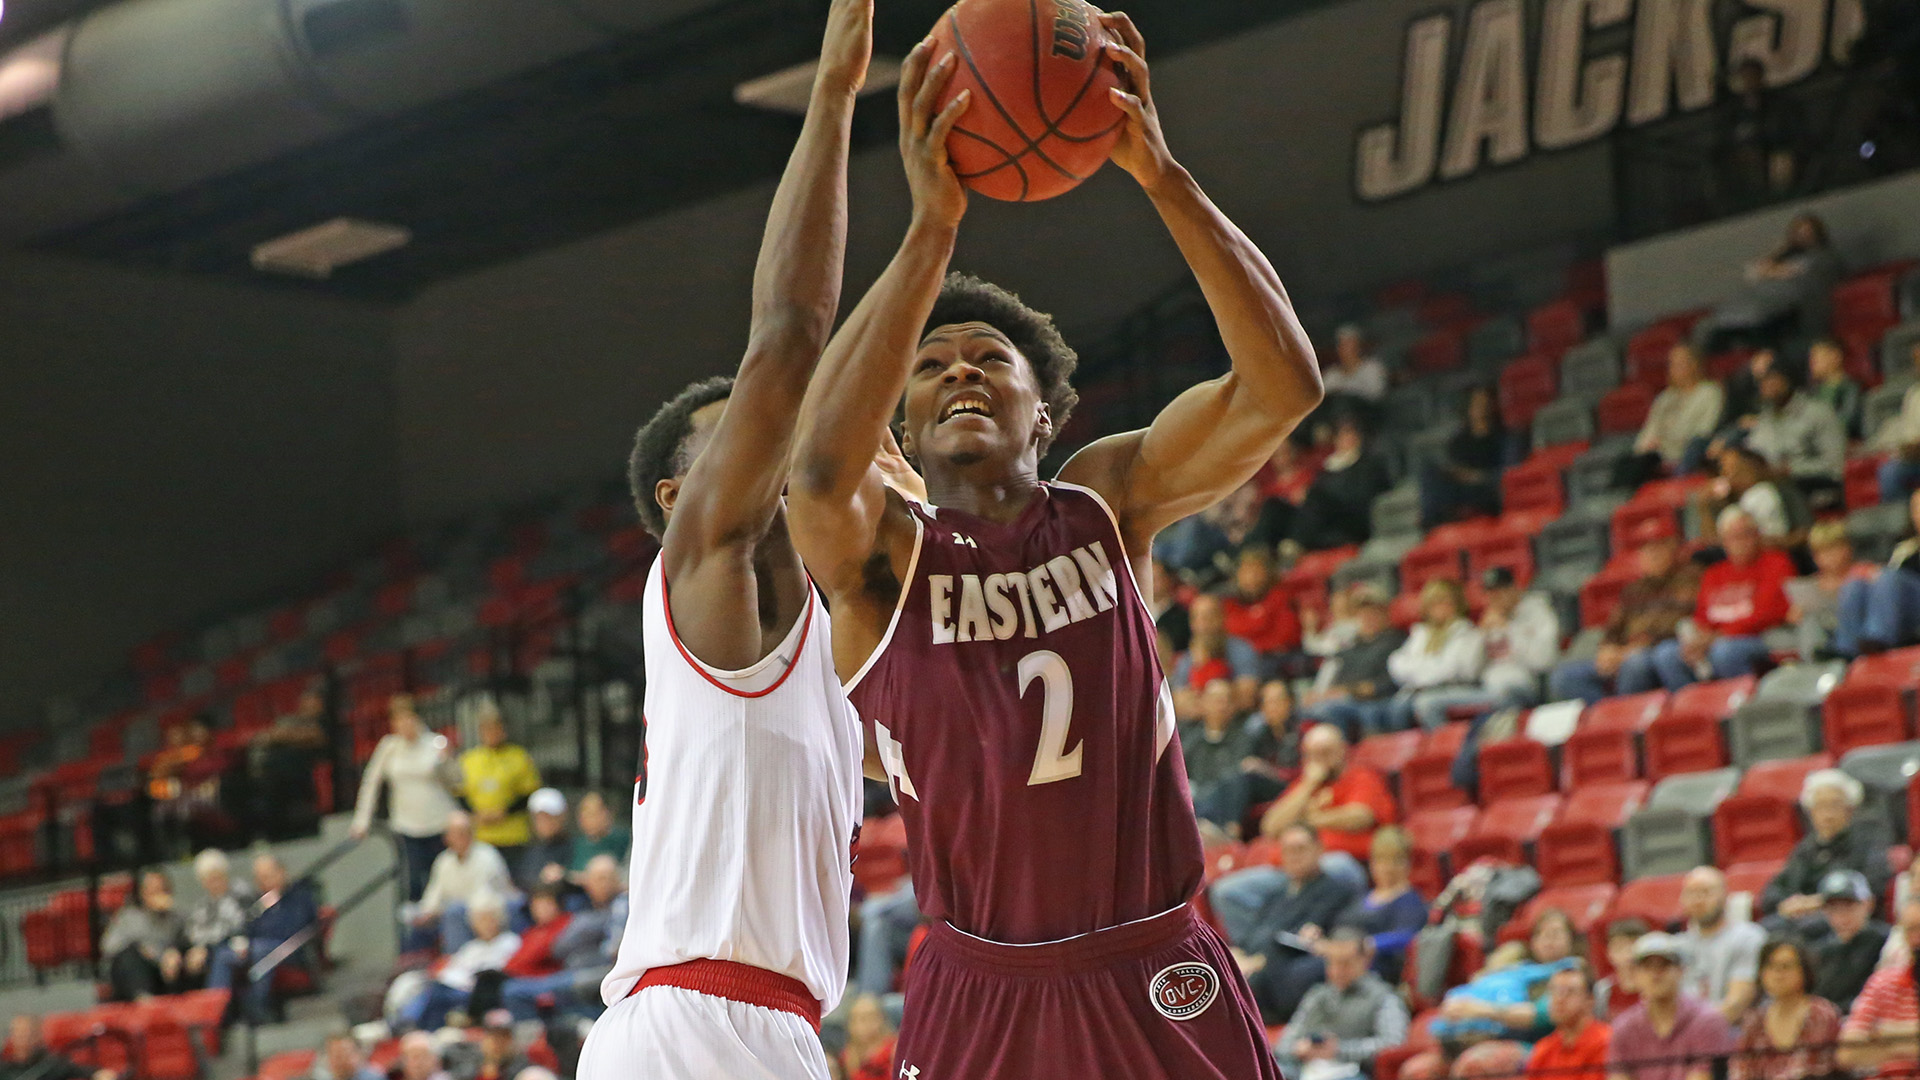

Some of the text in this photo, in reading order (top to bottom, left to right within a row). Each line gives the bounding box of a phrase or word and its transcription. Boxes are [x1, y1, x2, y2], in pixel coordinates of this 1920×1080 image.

[928, 540, 1118, 645] EASTERN
[1017, 649, 1084, 787] 2
[1167, 991, 1210, 1014] CONFERENCE
